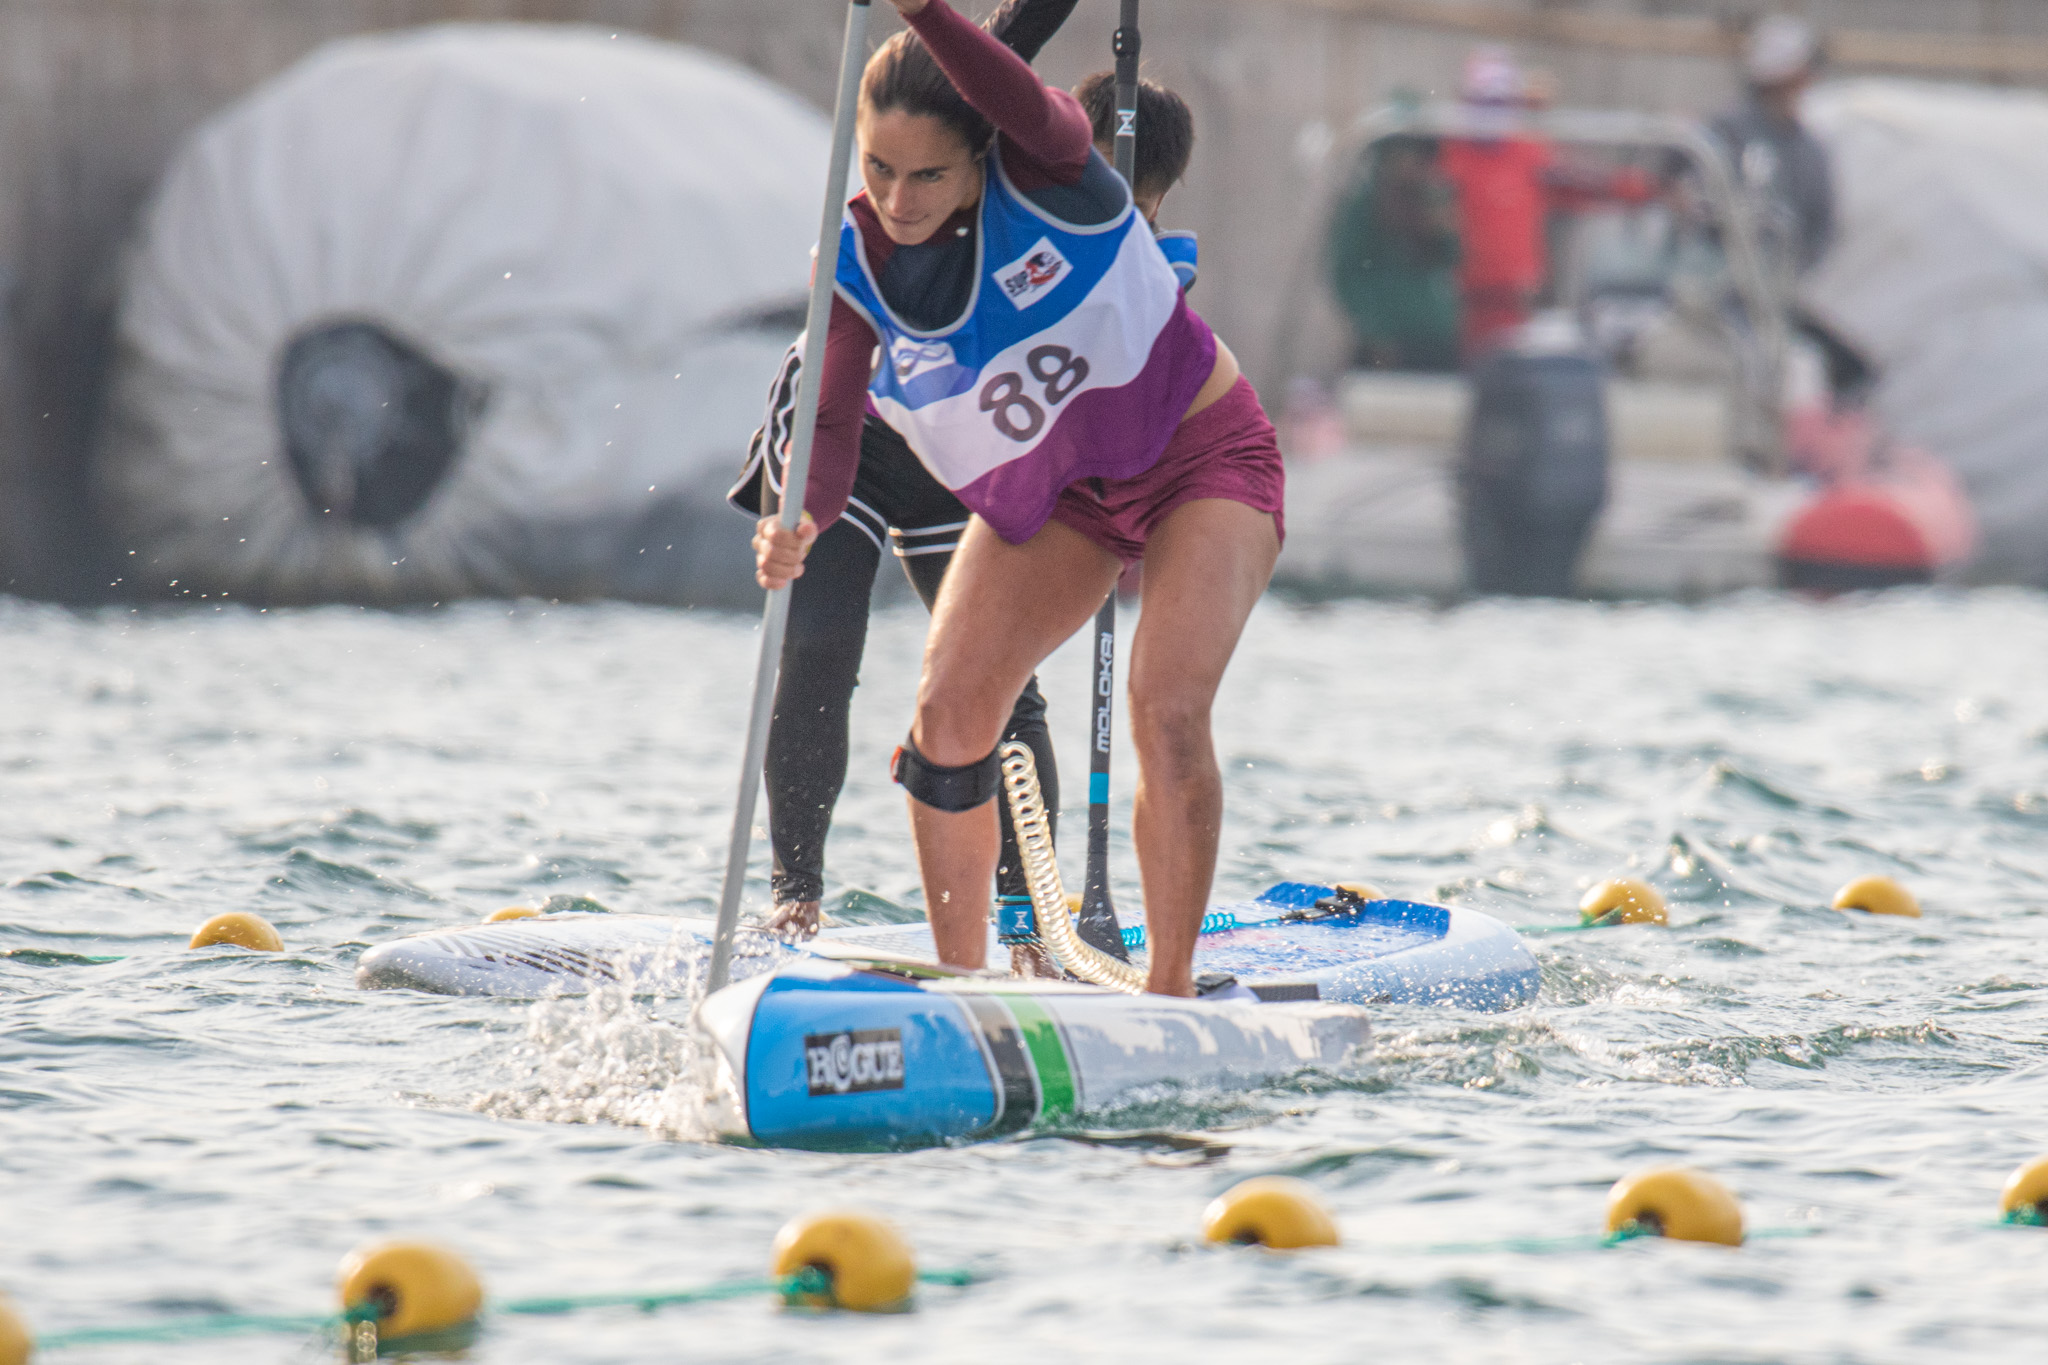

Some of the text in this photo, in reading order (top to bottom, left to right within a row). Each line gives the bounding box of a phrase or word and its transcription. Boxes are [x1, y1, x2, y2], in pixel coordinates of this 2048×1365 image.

[980, 344, 1089, 442] 88
[1097, 631, 1113, 753] MOLOKAI
[807, 1034, 903, 1092] ROGUE
